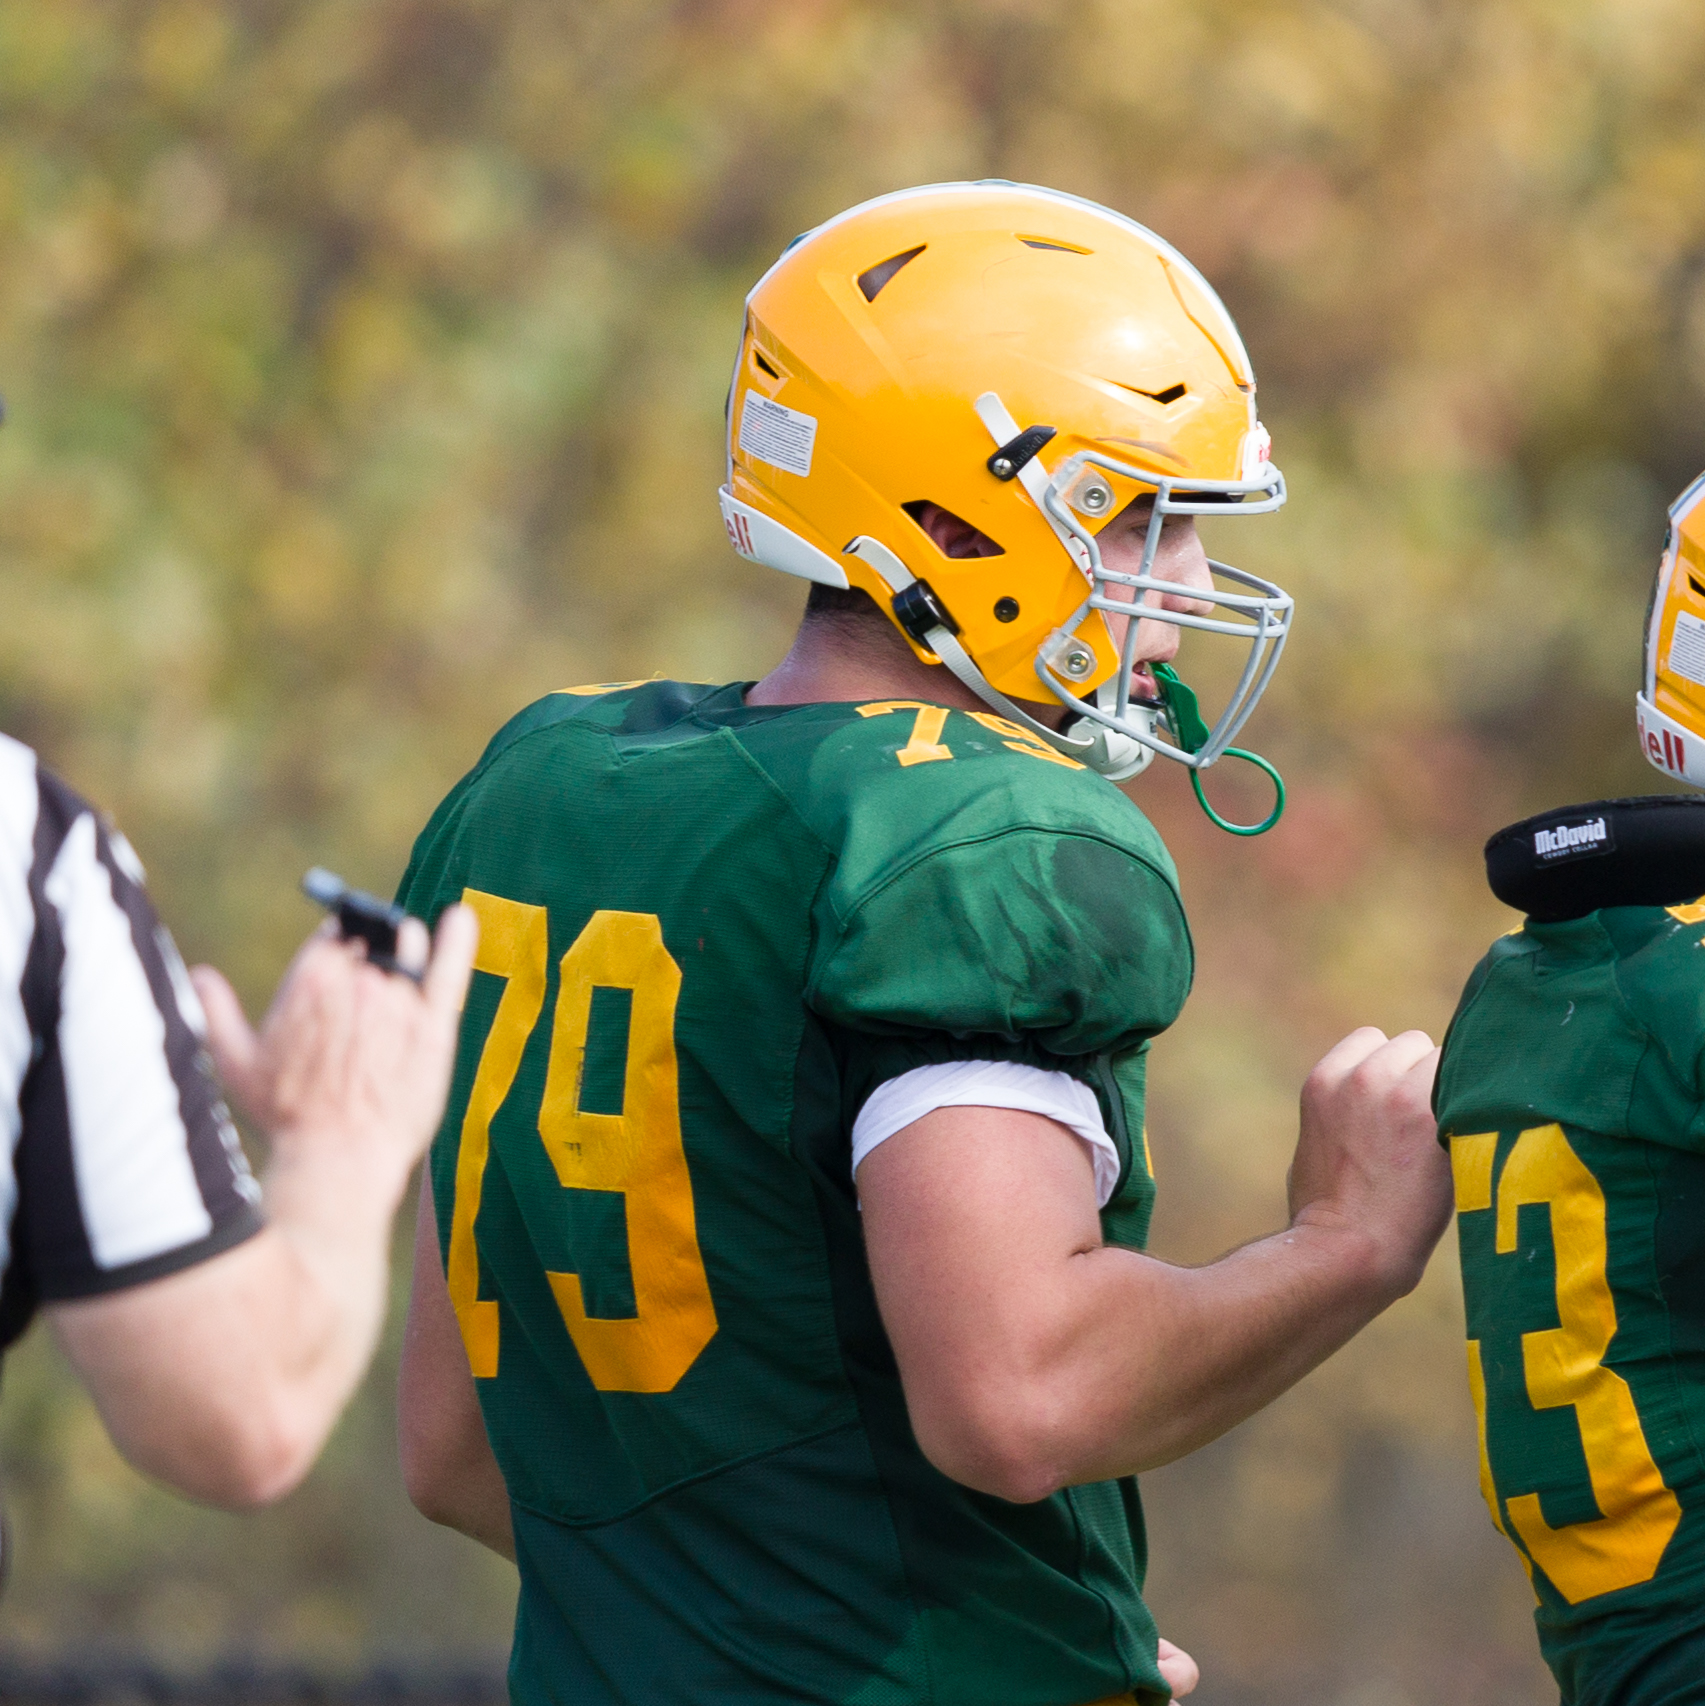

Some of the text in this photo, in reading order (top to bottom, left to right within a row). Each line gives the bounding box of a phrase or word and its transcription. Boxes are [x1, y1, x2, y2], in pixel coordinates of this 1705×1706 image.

[854, 700, 1088, 771] 79
[1534, 817, 1606, 855] McDavid
[446, 888, 719, 1394] 79
